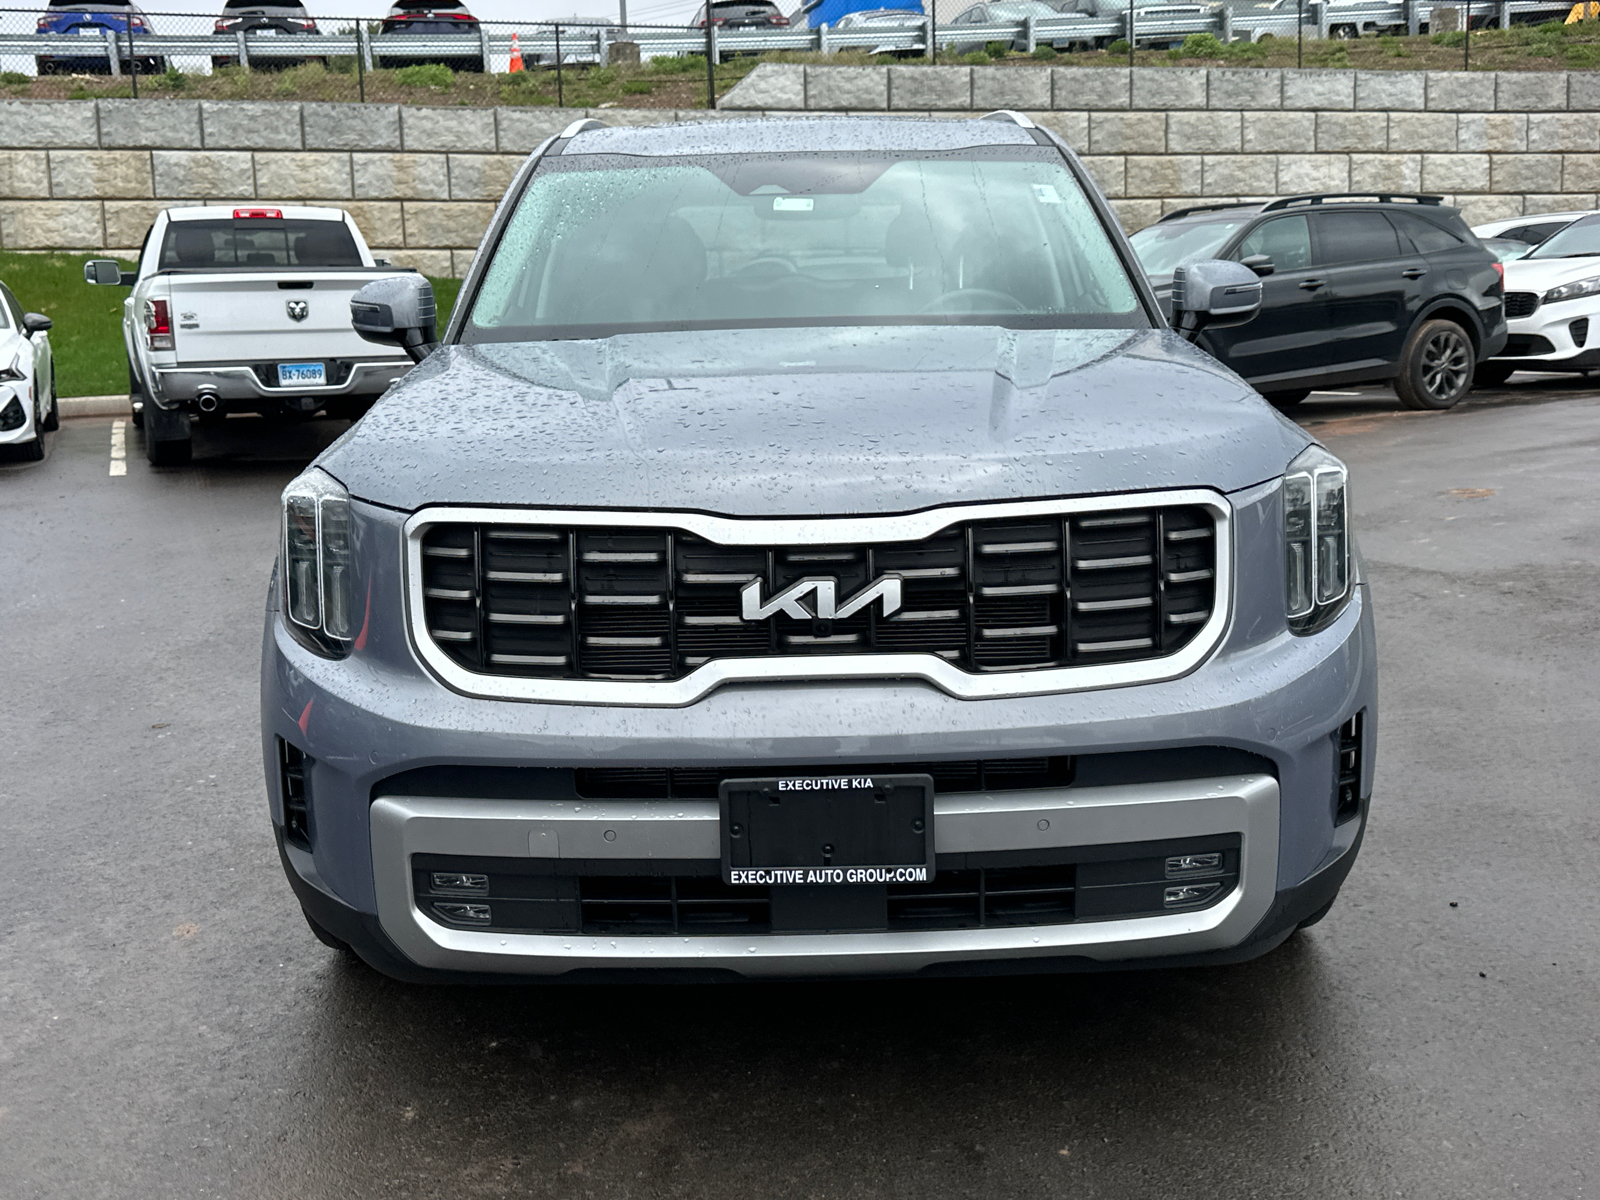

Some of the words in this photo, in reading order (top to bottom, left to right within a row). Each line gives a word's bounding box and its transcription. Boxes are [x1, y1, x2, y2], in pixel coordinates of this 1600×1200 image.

[741, 575, 902, 620] KIA
[778, 778, 849, 791] EXECUTIVE
[852, 778, 874, 789] KIA
[730, 869, 804, 884] EXECUTIVE
[806, 869, 844, 883] AUTO
